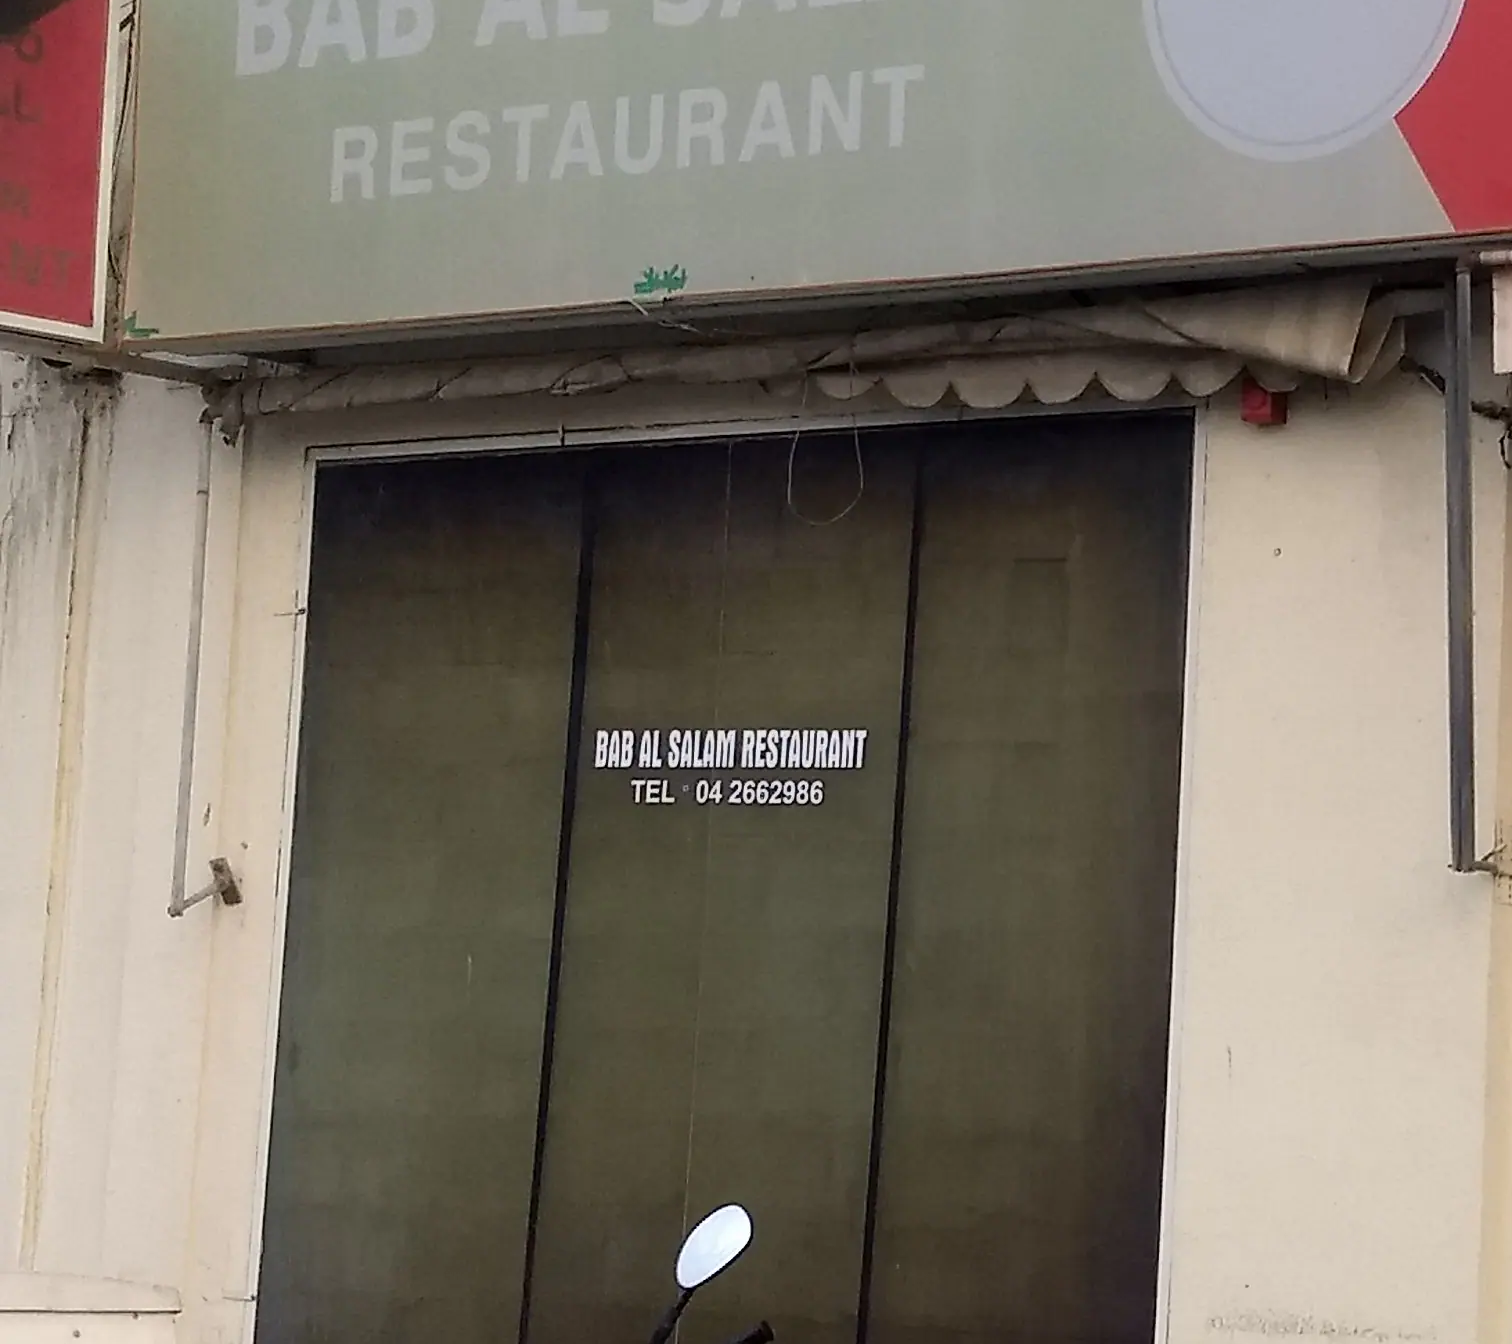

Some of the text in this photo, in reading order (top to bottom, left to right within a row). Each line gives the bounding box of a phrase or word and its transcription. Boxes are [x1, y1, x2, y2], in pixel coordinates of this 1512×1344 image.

[328, 64, 926, 204] RESTAURANT
[594, 729, 868, 769] BAB AL SALAM RESTAURANT
[630, 779, 824, 806] TEL 04 2662986
